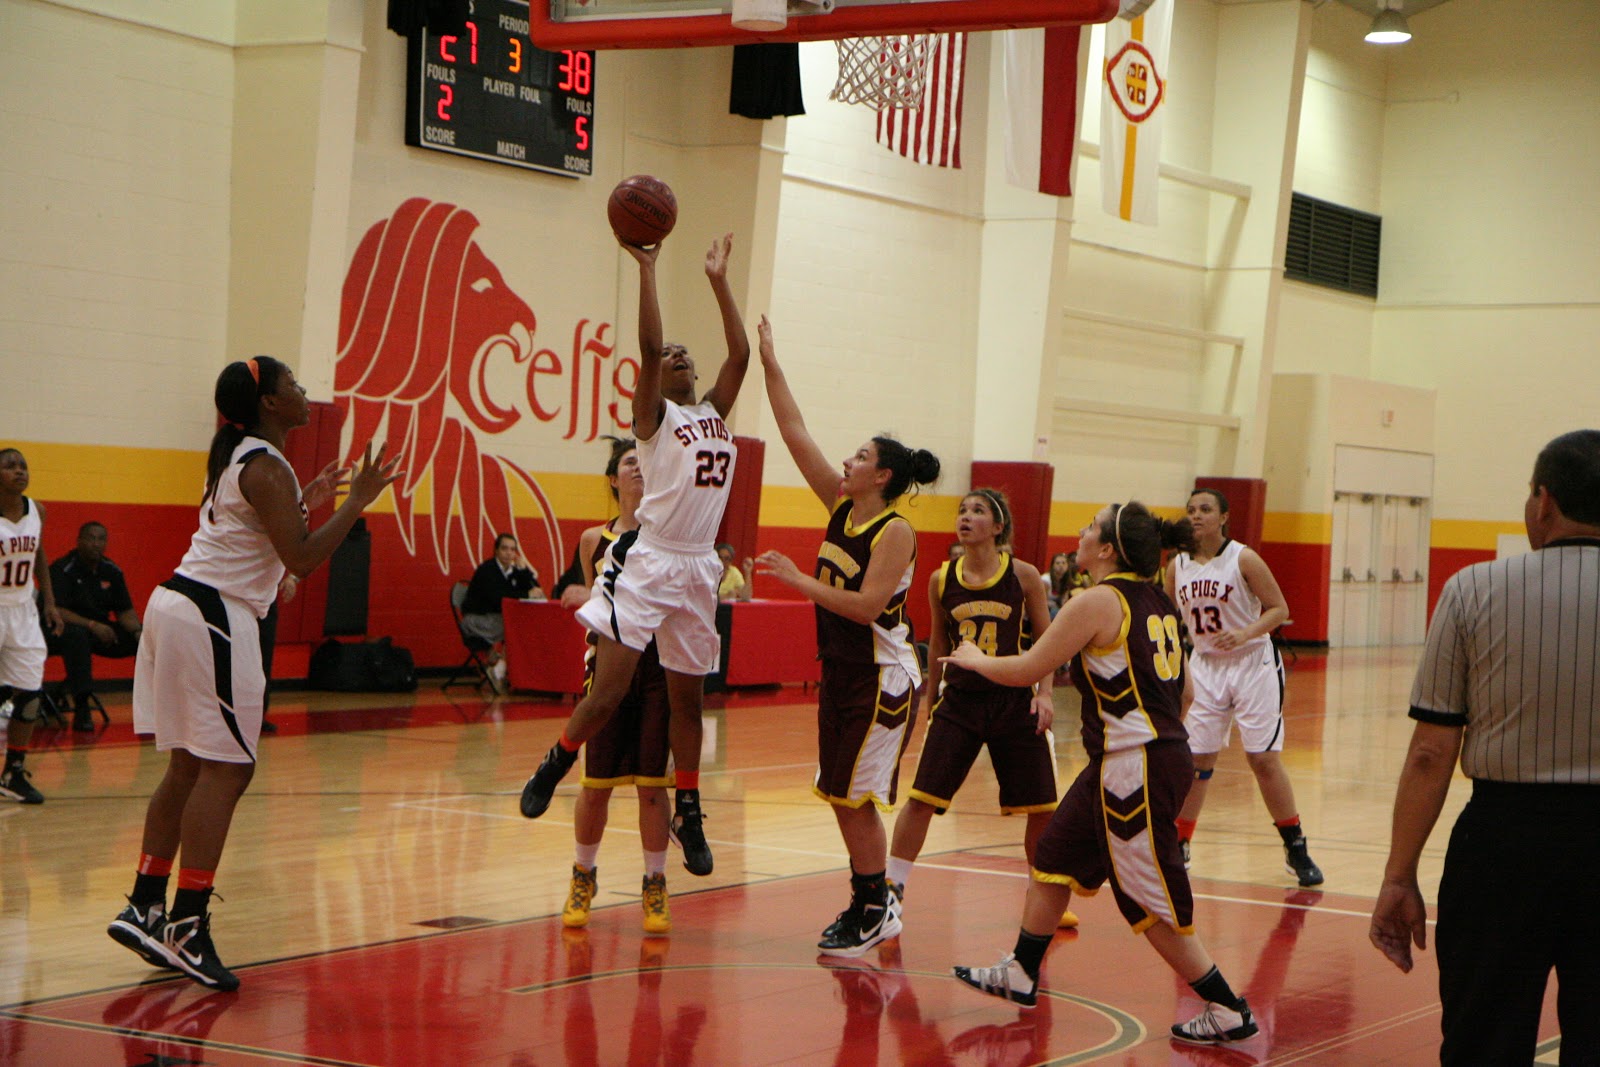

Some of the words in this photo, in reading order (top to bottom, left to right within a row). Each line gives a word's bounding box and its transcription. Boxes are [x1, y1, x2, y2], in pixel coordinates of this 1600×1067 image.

[499, 14, 529, 35] PERIOD
[508, 37, 521, 73] 3
[426, 63, 456, 84] FOULS
[558, 50, 591, 95] 38
[437, 84, 453, 120] 2
[483, 77, 515, 98] PLAYER
[520, 86, 541, 104] FOUL
[566, 97, 591, 115] FOULS
[426, 126, 455, 146] SCORE
[575, 116, 588, 150] 5
[497, 141, 525, 160] MATCH
[564, 155, 590, 173] SCORE
[674, 424, 698, 447] ST
[697, 417, 729, 441] PIUS
[695, 450, 731, 488] 23
[9, 536, 36, 553] PIUS
[2, 560, 31, 587] 10
[1191, 579, 1219, 598] PIUS
[1219, 584, 1234, 603] X
[1191, 606, 1222, 635] 13
[1147, 614, 1182, 681] 33
